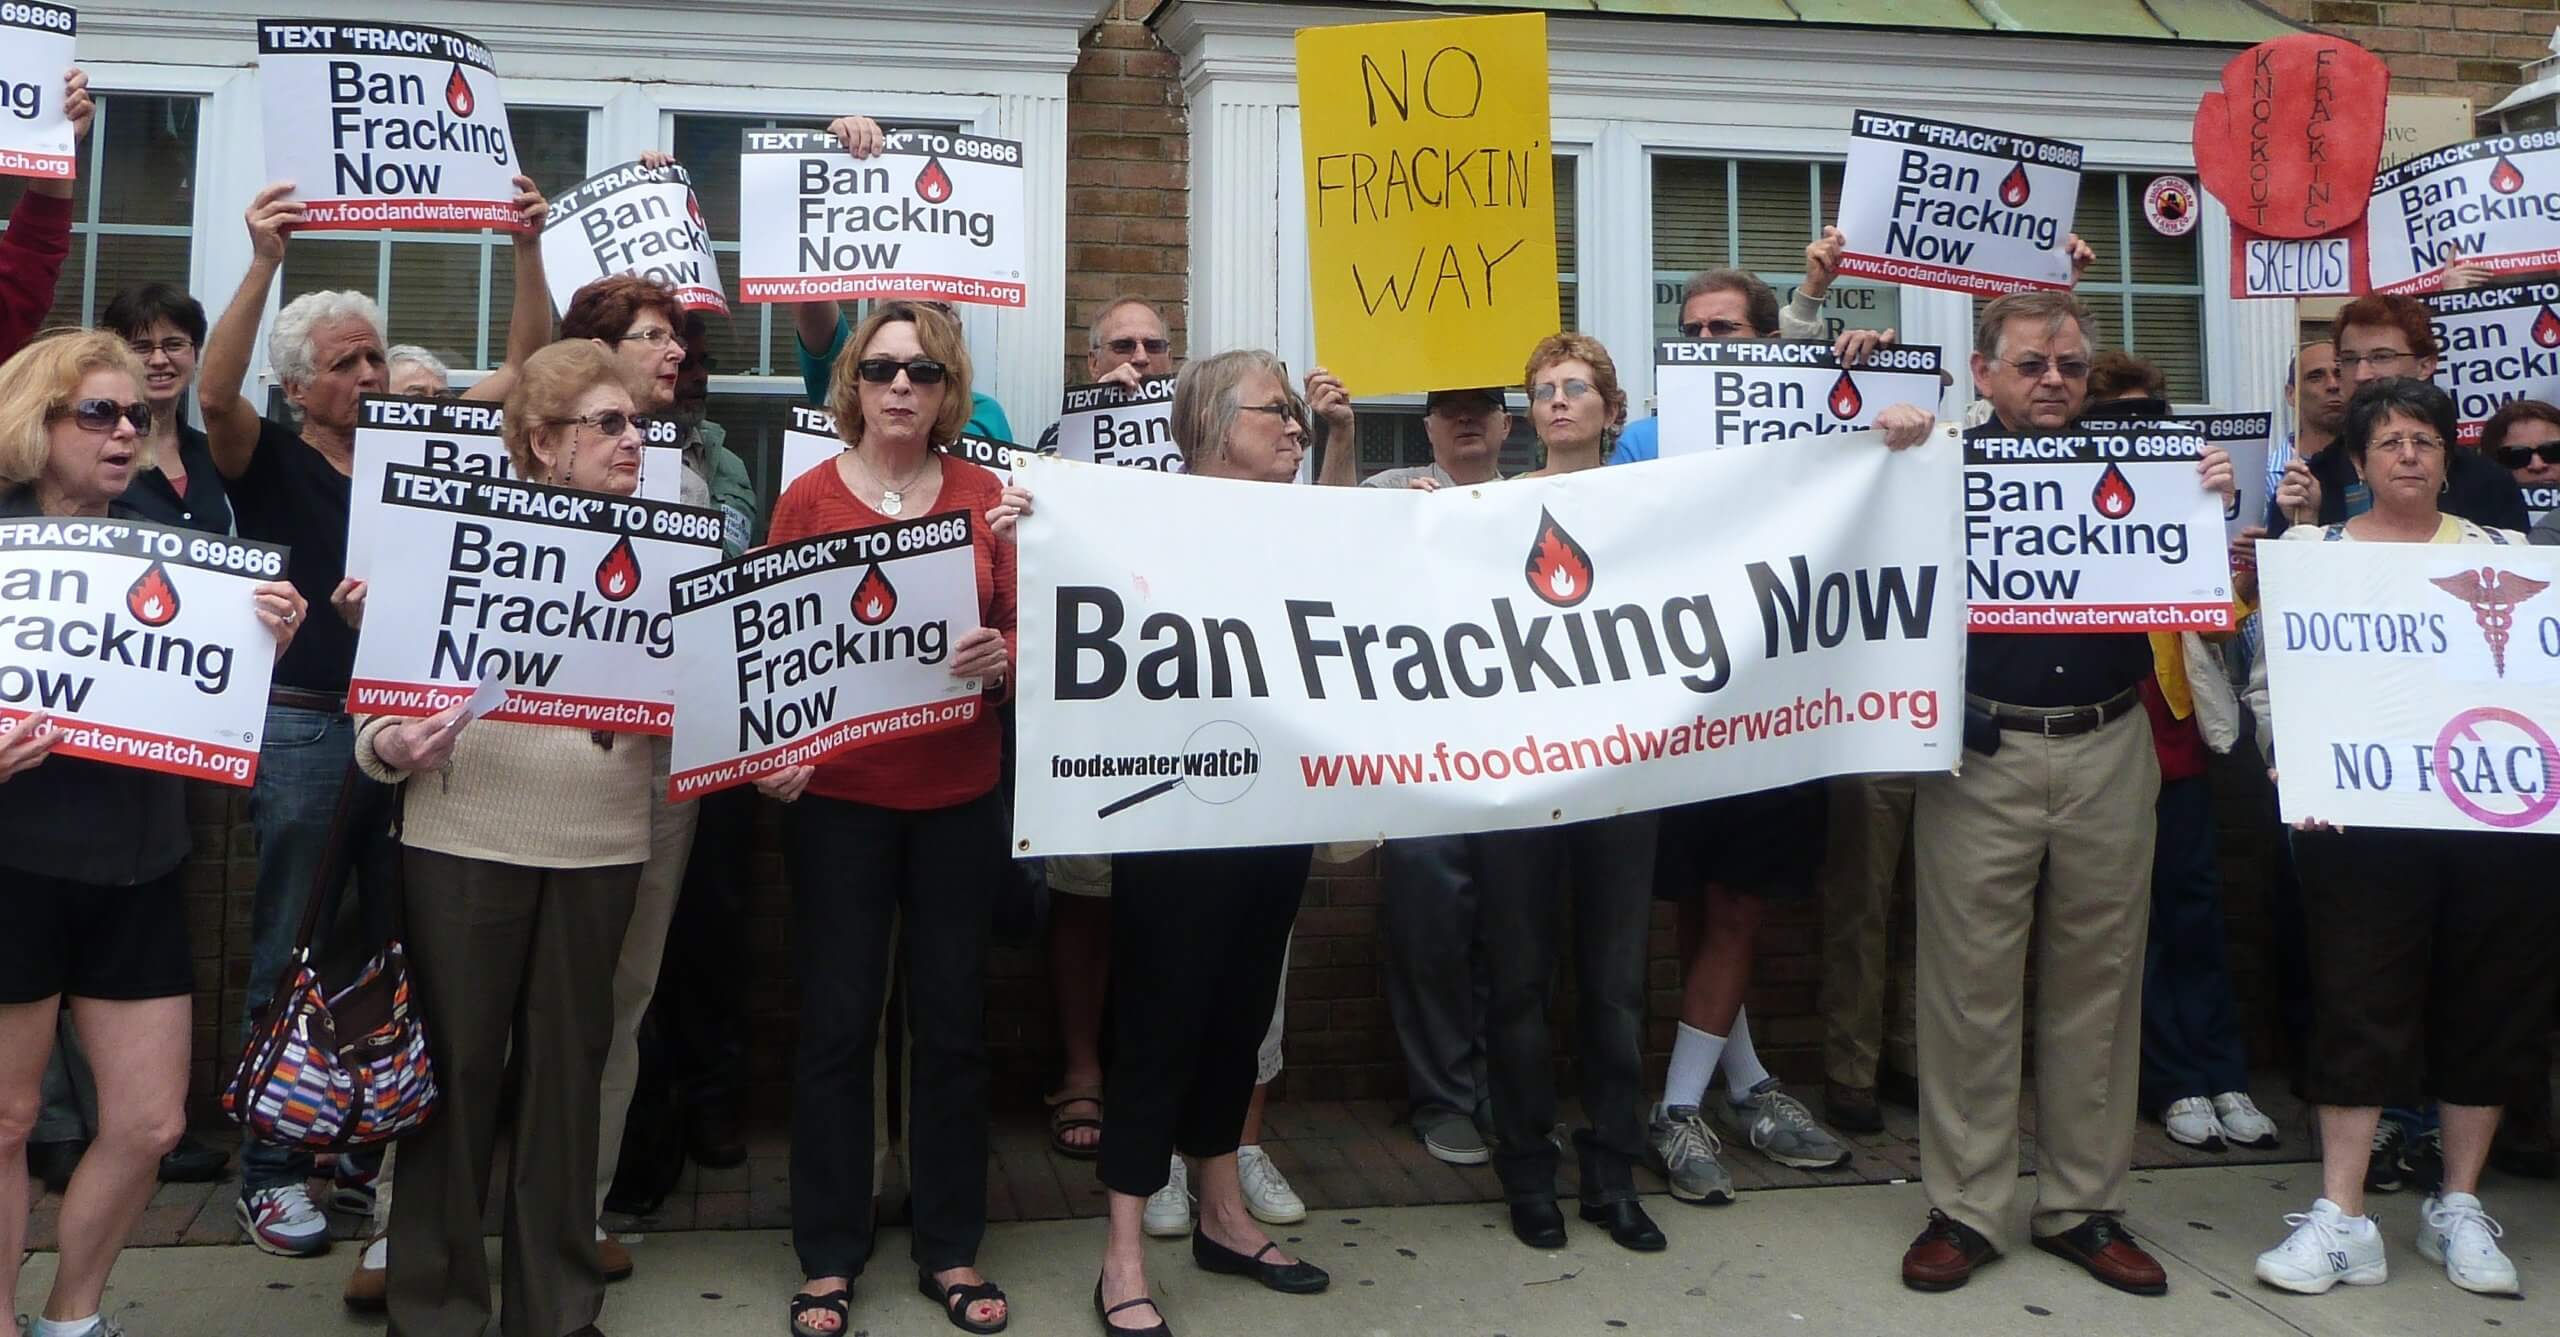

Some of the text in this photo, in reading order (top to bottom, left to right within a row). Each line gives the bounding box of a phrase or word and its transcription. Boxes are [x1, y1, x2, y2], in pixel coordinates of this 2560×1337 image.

[1, 3, 72, 31] 69866
[264, 26, 336, 48] TEXT
[342, 27, 439, 54] “FRACK”
[441, 36, 464, 58] TO
[329, 61, 426, 105] Ban
[1361, 46, 1482, 128] NO
[332, 106, 508, 166] Fracking
[748, 132, 1019, 163] TEXT “FK” TO 69866
[1858, 115, 2081, 168] TEXT “FRACK” TO 69866
[2247, 49, 2273, 226] KNOCKOUT
[2304, 49, 2338, 230] FRACKING
[334, 153, 442, 195] Now
[799, 158, 889, 195] Ban
[1898, 149, 1979, 194] Ban
[2373, 170, 2400, 192] EXT
[2403, 144, 2480, 178] “FRACK”
[2484, 138, 2515, 155] TO
[2518, 131, 2560, 151] 698
[547, 192, 580, 223] EXT
[2400, 174, 2468, 217] Ban
[579, 193, 671, 246] Ban
[799, 197, 994, 247] Fracking
[1892, 186, 2058, 251] Fracking
[799, 236, 902, 273] Now
[1885, 222, 1976, 266] Now
[2411, 232, 2486, 274] Now
[625, 261, 700, 285] ow
[746, 277, 1021, 302] www.foodandwaterwatch.org
[1352, 239, 1525, 316] WAY
[2249, 241, 2343, 293] SKELOS
[2429, 283, 2560, 313] “FRACK” TO
[1662, 342, 1722, 361] TEXT
[1727, 343, 1825, 364] “FRACK”
[1867, 350, 1937, 370] 69866
[2431, 322, 2508, 353] Ban
[1066, 388, 1102, 410] TEXT
[1714, 371, 1805, 409] Ban
[365, 400, 505, 431] TEXT “FRA
[792, 406, 839, 434] TEX
[961, 438, 996, 462] TO
[1093, 414, 1172, 451] Ban
[2210, 418, 2267, 437] 69866
[1973, 436, 2088, 460] “FRACK”
[2091, 436, 2131, 458] TO
[392, 472, 472, 507] TEXT
[477, 484, 605, 524] “FRACK”
[609, 503, 648, 531] TO
[652, 509, 721, 541] 69866
[1963, 471, 2064, 512] Ban
[0, 523, 283, 576] FRACK” TO 69866
[449, 521, 566, 584] Ban
[1965, 514, 2188, 565] Fracking
[675, 518, 967, 608] TEXT “FRACK” TO 69866
[1966, 559, 2081, 600] Now
[0, 567, 89, 605] an
[440, 576, 674, 659] Fracking
[733, 592, 822, 654] Ban
[1054, 554, 1939, 701] Ban Fracking Now
[1966, 606, 2228, 629] foodandwaterwatch.org
[2283, 611, 2448, 654] DOCTOR'S
[0, 612, 235, 695] acking
[430, 629, 564, 687] Now
[737, 618, 949, 704] Fracking
[0, 664, 96, 714] ow
[739, 685, 838, 753] Now
[1300, 687, 1938, 788] www.foodandwaterwatch.org
[676, 701, 976, 793] www.foodandwaterwatch.org
[2331, 742, 2394, 791] NO
[2327, 1251, 2348, 1272] N
